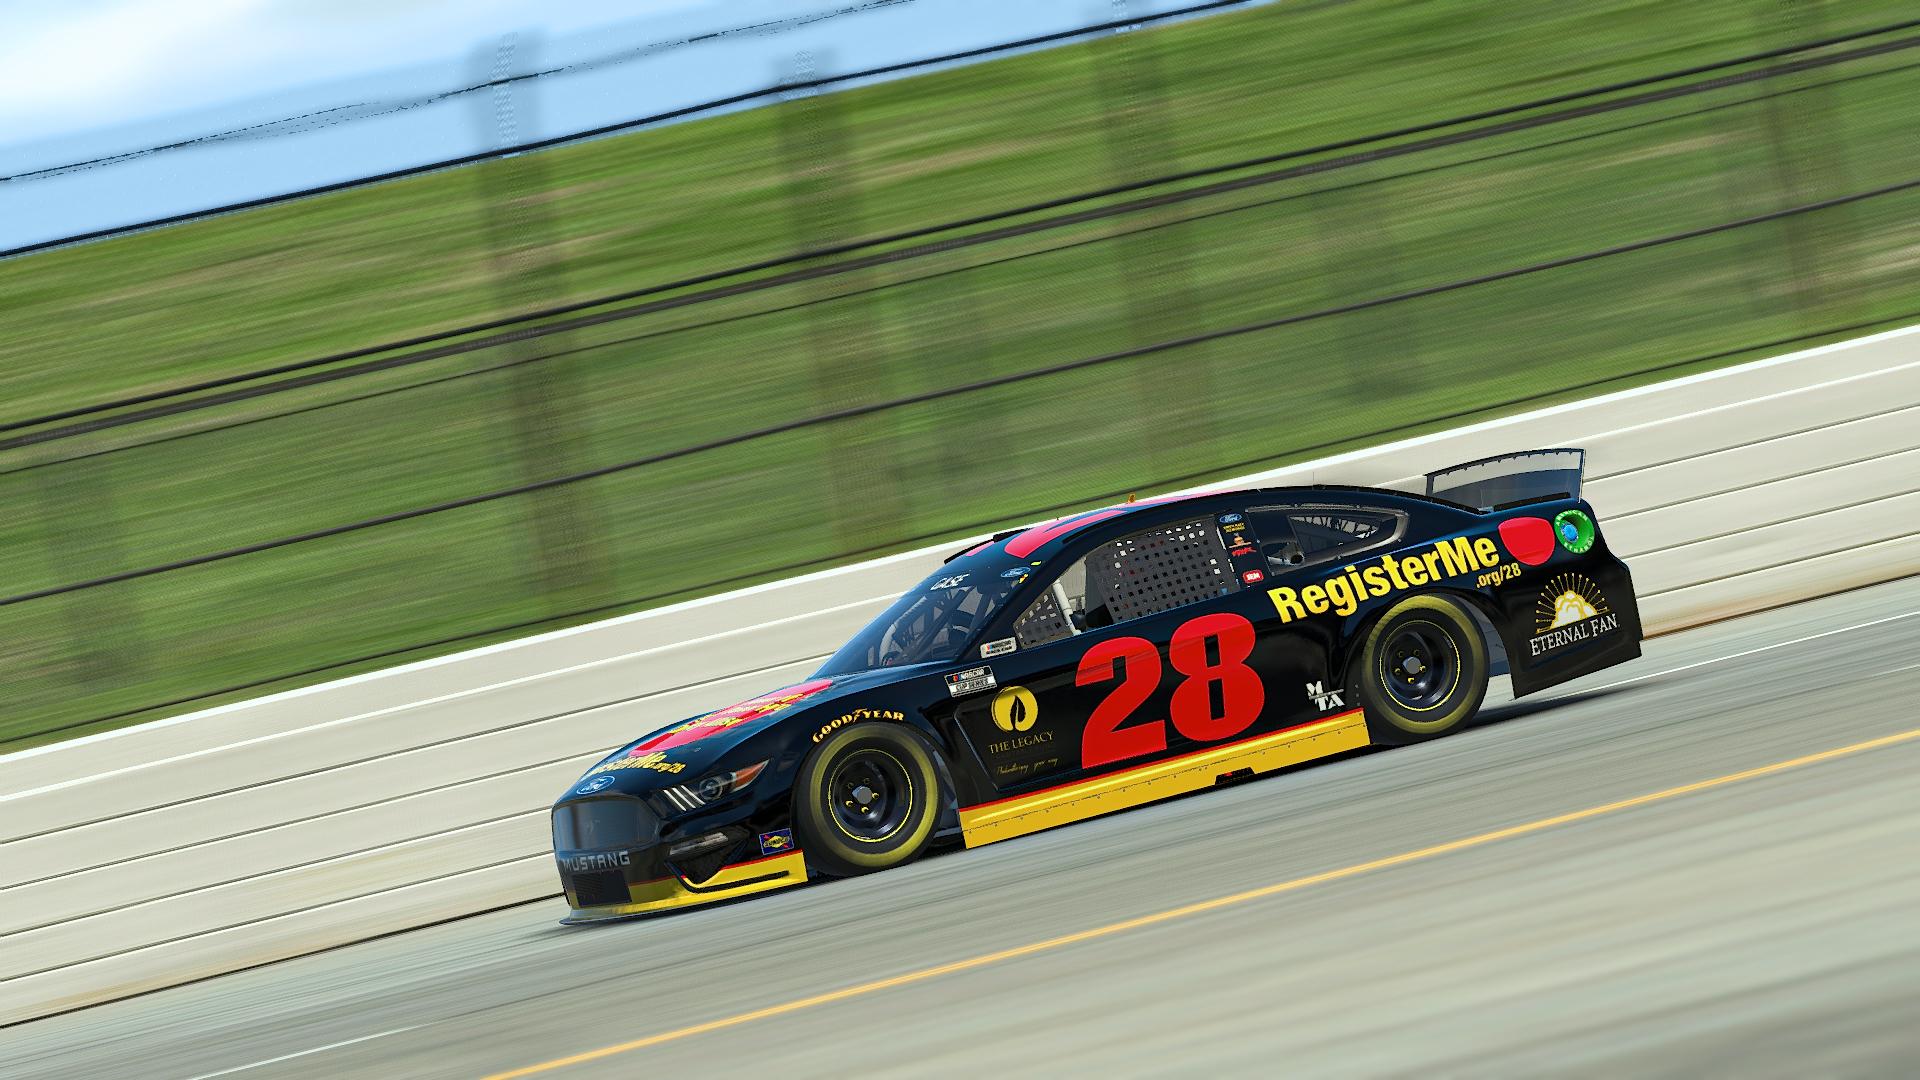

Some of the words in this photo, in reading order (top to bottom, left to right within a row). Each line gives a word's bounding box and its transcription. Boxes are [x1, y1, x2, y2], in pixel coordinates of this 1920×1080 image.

[1266, 536, 1500, 624] RegisterMe
[1476, 562, 1522, 588] .org/28
[1529, 622, 1590, 657] ETERNAL
[1590, 613, 1618, 638] FAN
[1075, 612, 1265, 770] 28
[988, 741, 1010, 754] THE
[1011, 730, 1054, 749] LEGACY
[562, 849, 631, 873] MUSTANG
